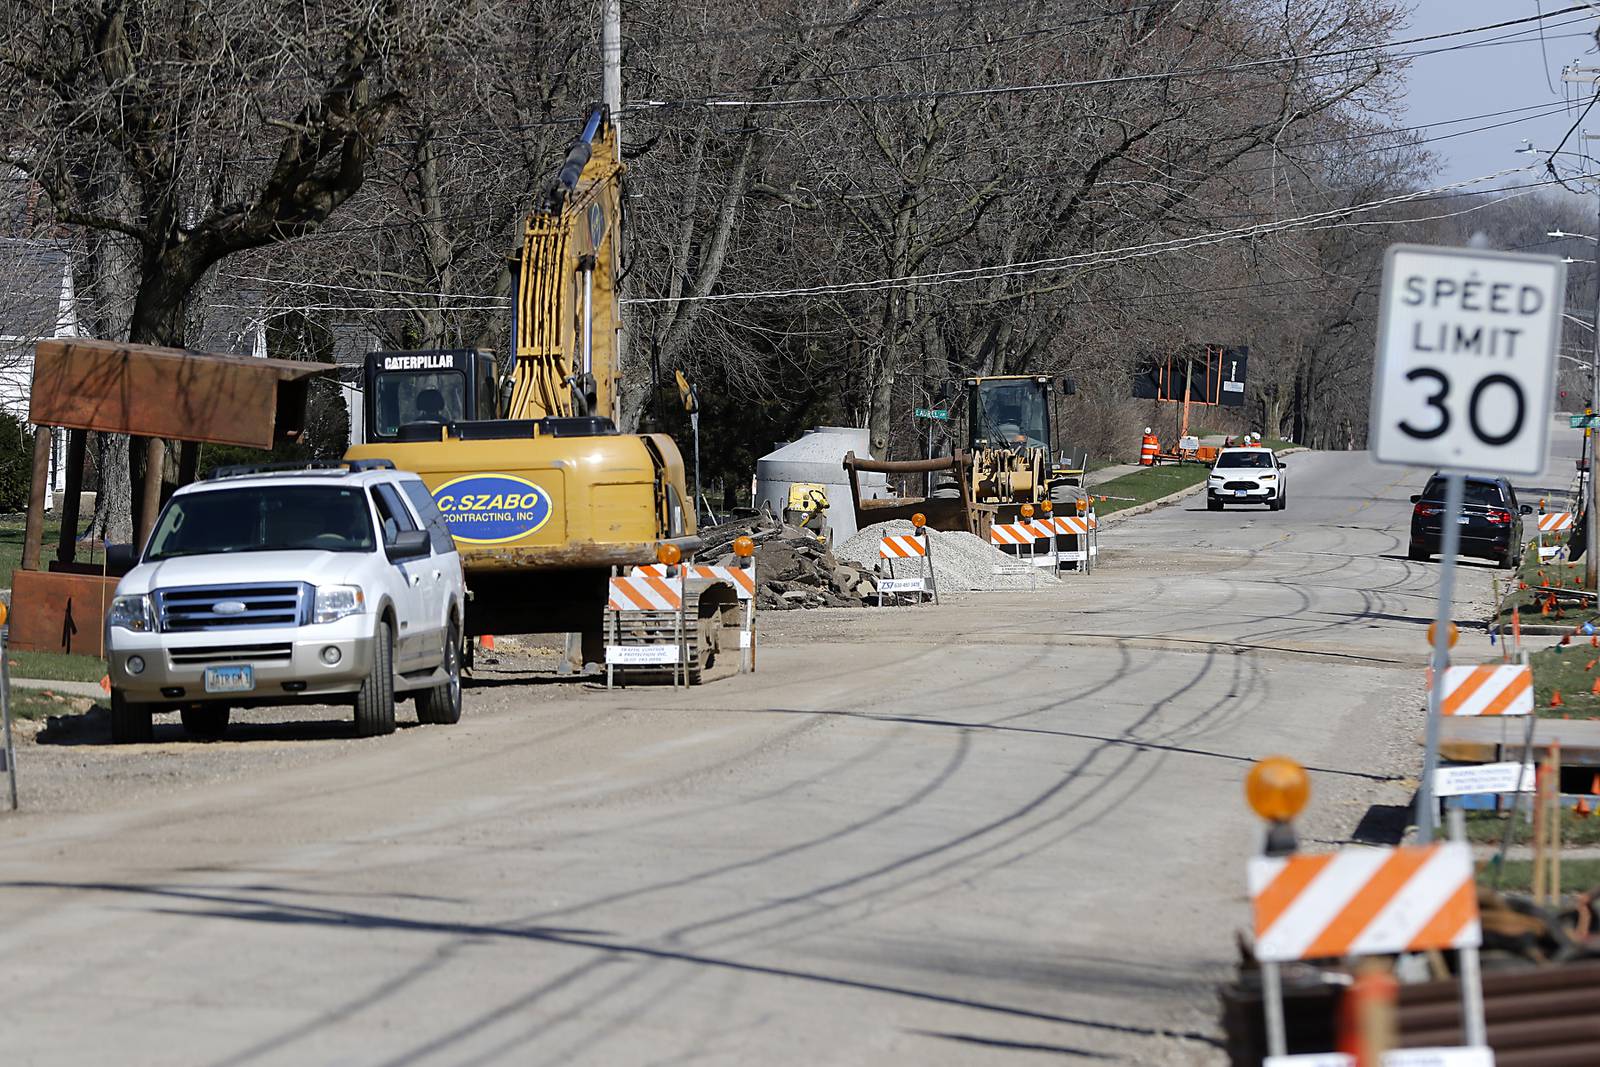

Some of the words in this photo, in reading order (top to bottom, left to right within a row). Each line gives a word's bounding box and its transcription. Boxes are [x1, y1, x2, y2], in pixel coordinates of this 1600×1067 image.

[1402, 277, 1544, 316] SPEED
[1413, 321, 1523, 358] LIMIT
[384, 354, 454, 370] CATERPILLAR
[1397, 367, 1526, 447] 30
[437, 493, 538, 512] C.SZABO
[516, 512, 534, 521] INC
